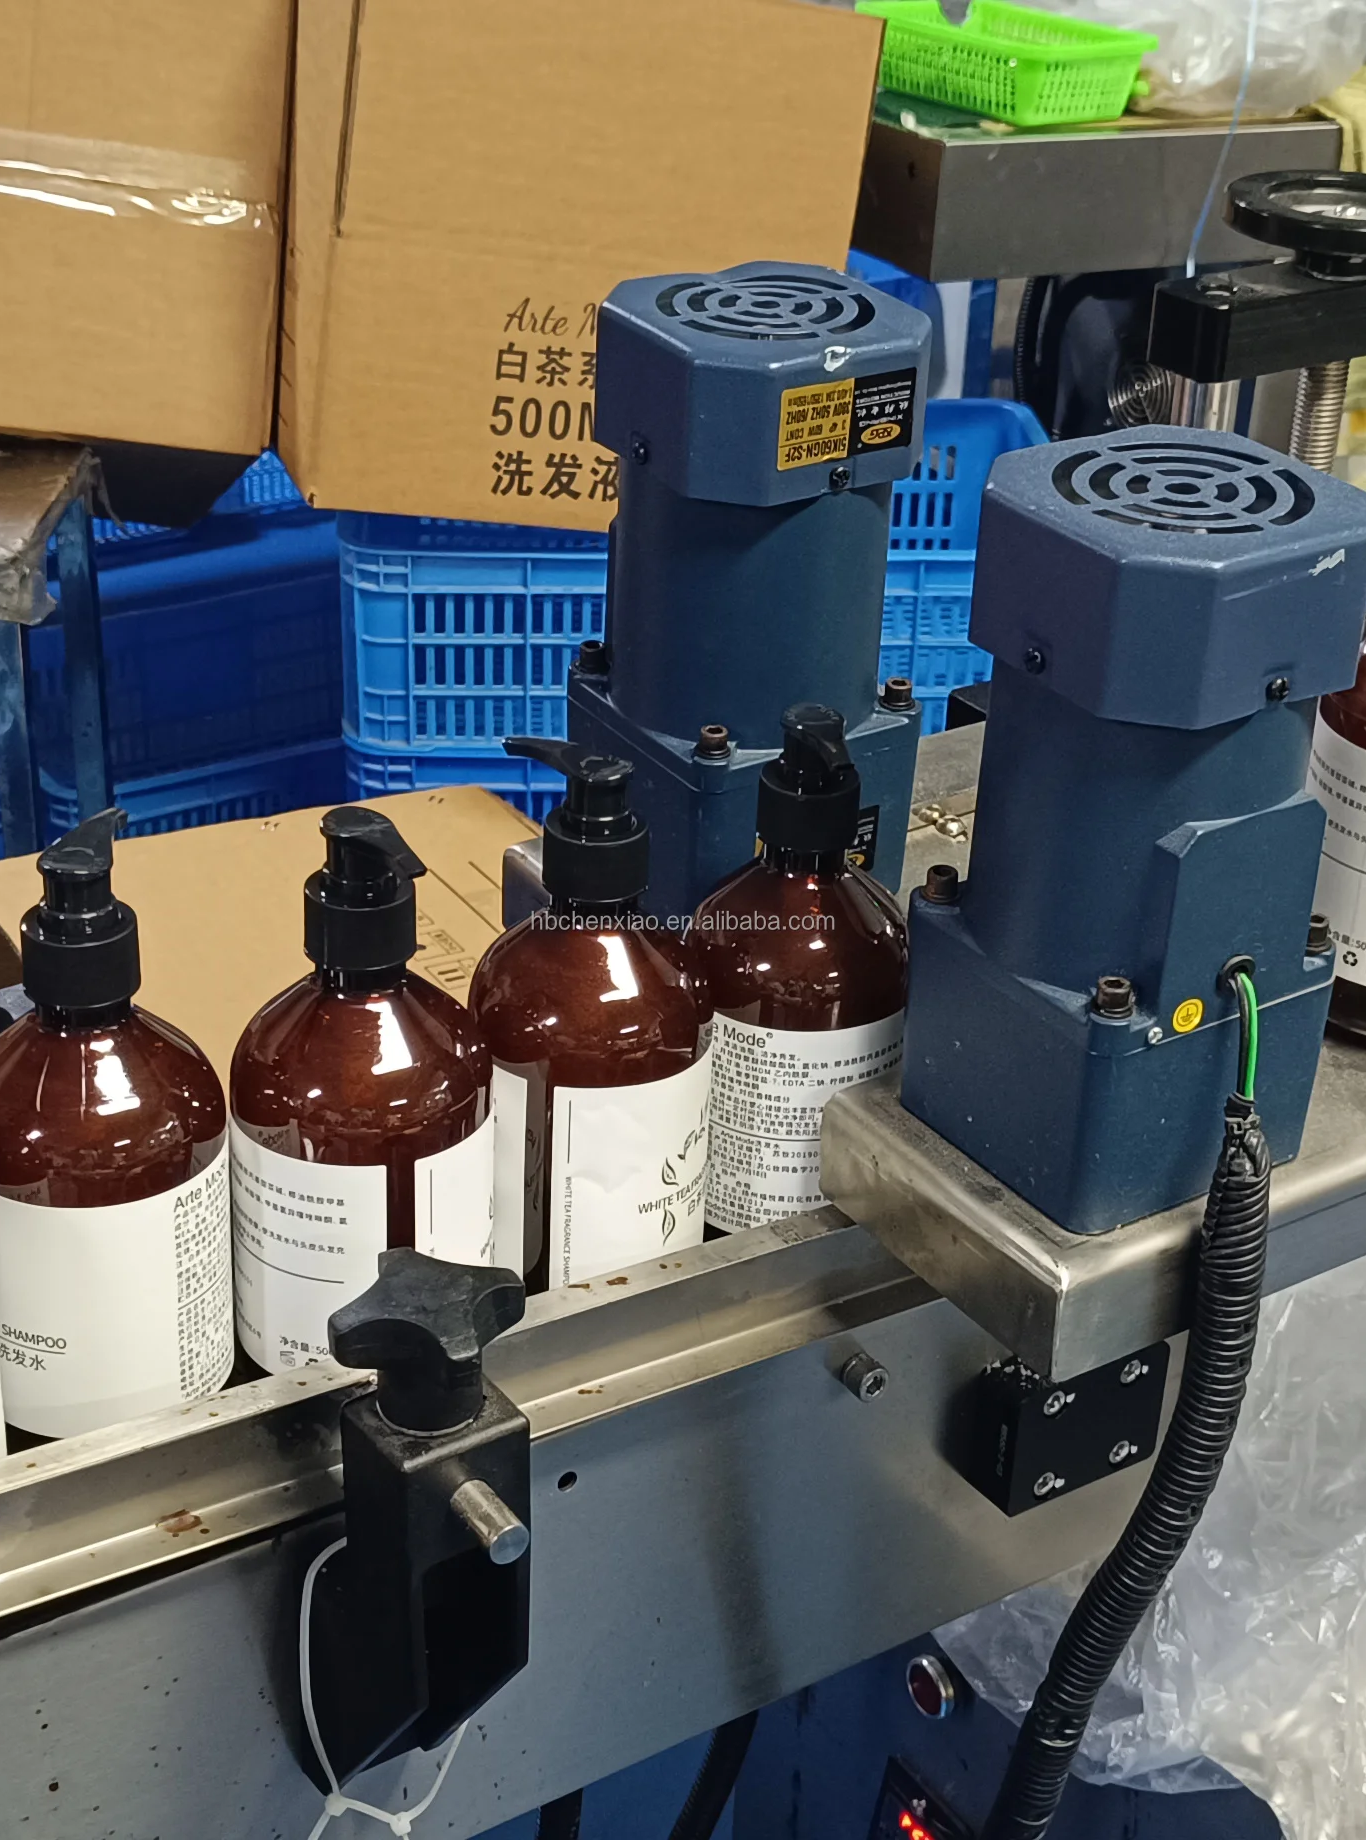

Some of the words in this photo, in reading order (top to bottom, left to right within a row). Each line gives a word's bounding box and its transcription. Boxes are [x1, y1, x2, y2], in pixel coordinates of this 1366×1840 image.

[503, 297, 569, 337] Arte
[490, 450, 620, 502] 洗发液
[173, 1187, 202, 1214] Arte
[564, 1176, 572, 1199] WHITE
[638, 1194, 675, 1215] WHITE
[562, 1255, 571, 1287] SHAMPO
[1, 1323, 67, 1350] SHAMPOO
